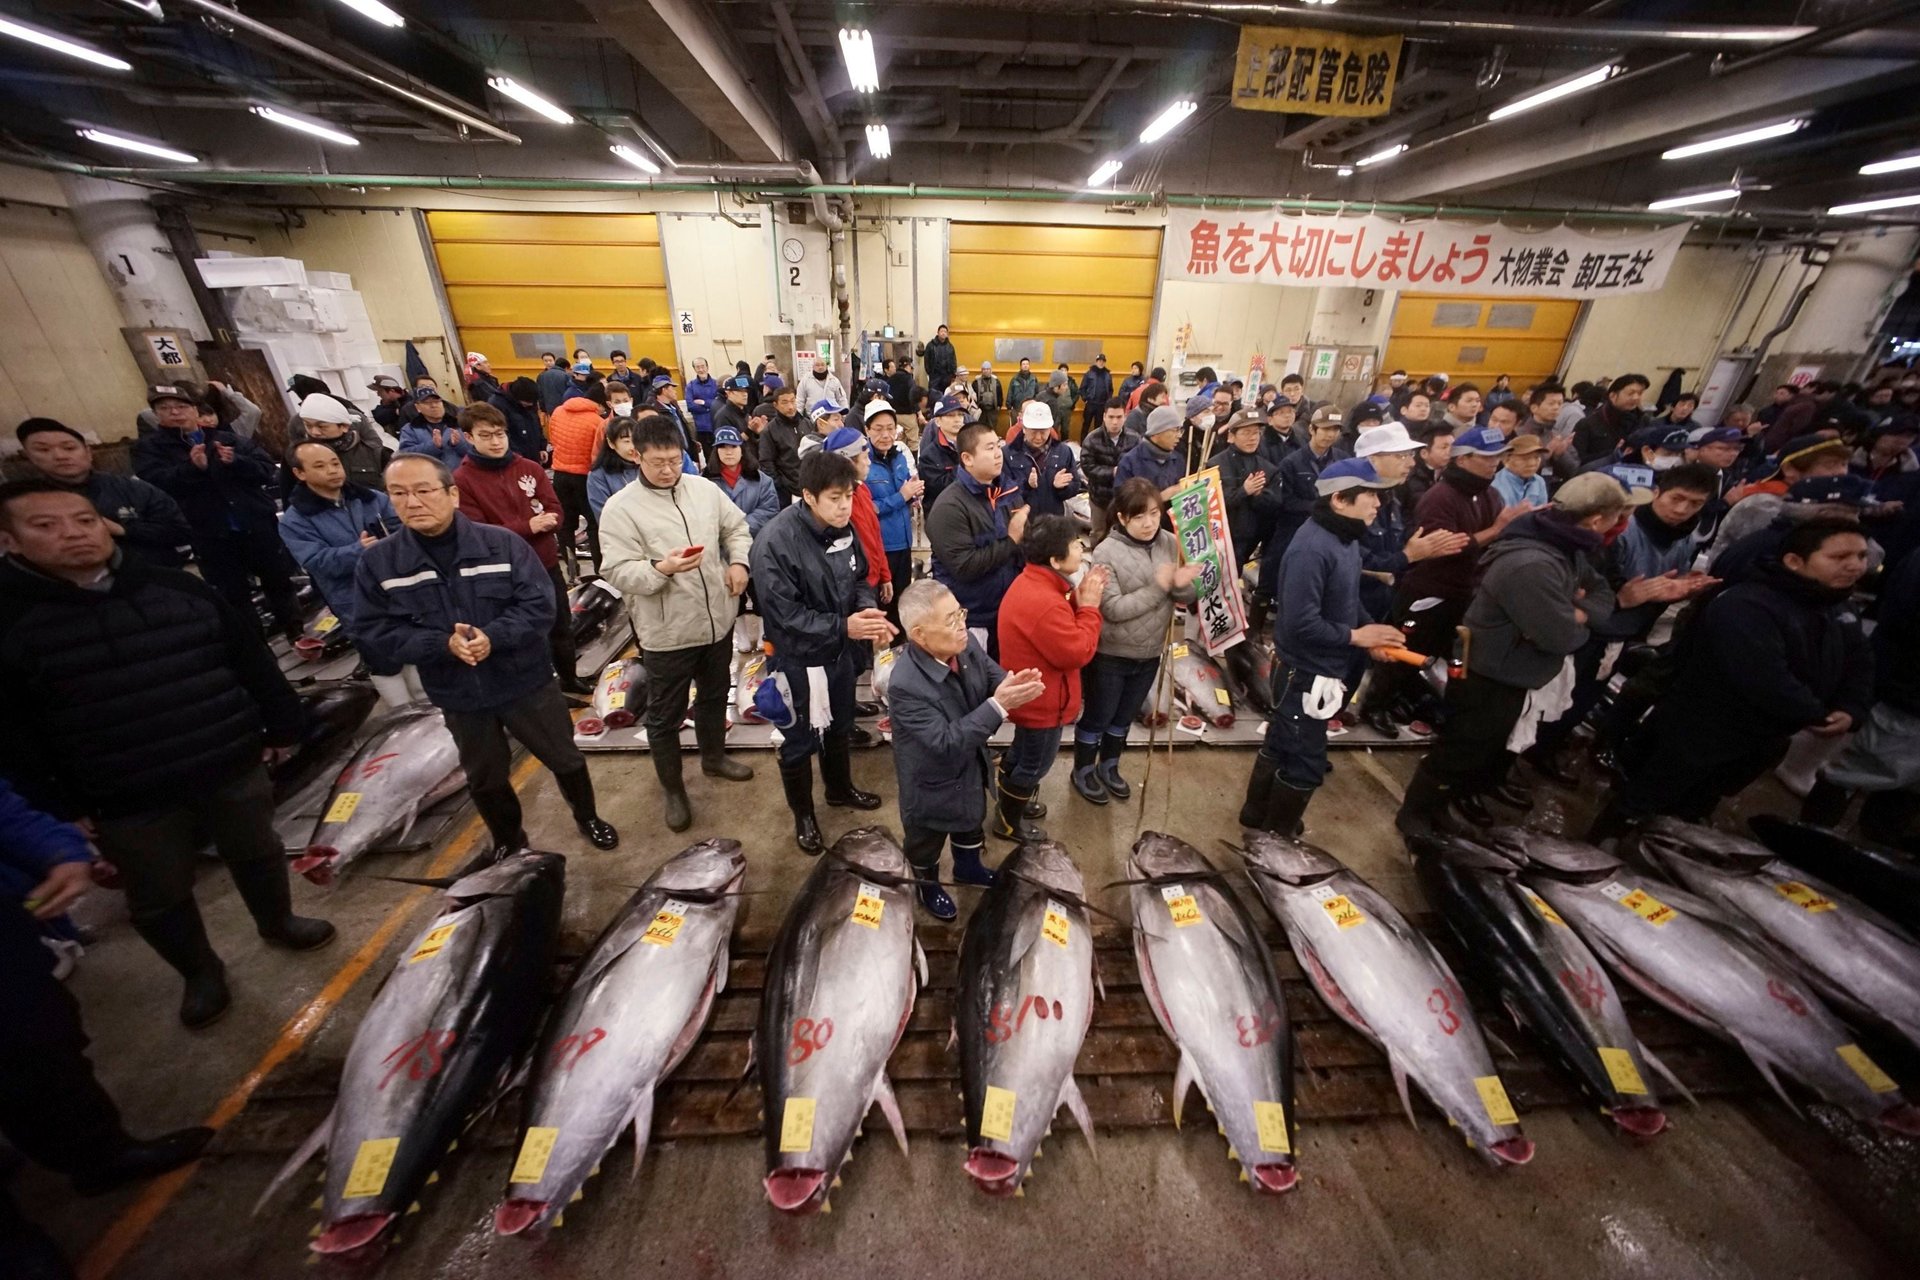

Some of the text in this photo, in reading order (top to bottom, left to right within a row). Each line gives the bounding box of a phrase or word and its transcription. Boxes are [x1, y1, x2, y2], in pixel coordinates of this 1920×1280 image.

[118, 253, 136, 275] 1
[1187, 219, 1654, 291] 魚を大切にしましょう 大物業会 卸五社
[789, 266, 801, 287] 2
[680, 312, 694, 334] 大都
[153, 337, 183, 365] 大都
[1181, 493, 1219, 591] 祝初荷
[787, 1017, 834, 1067] 80
